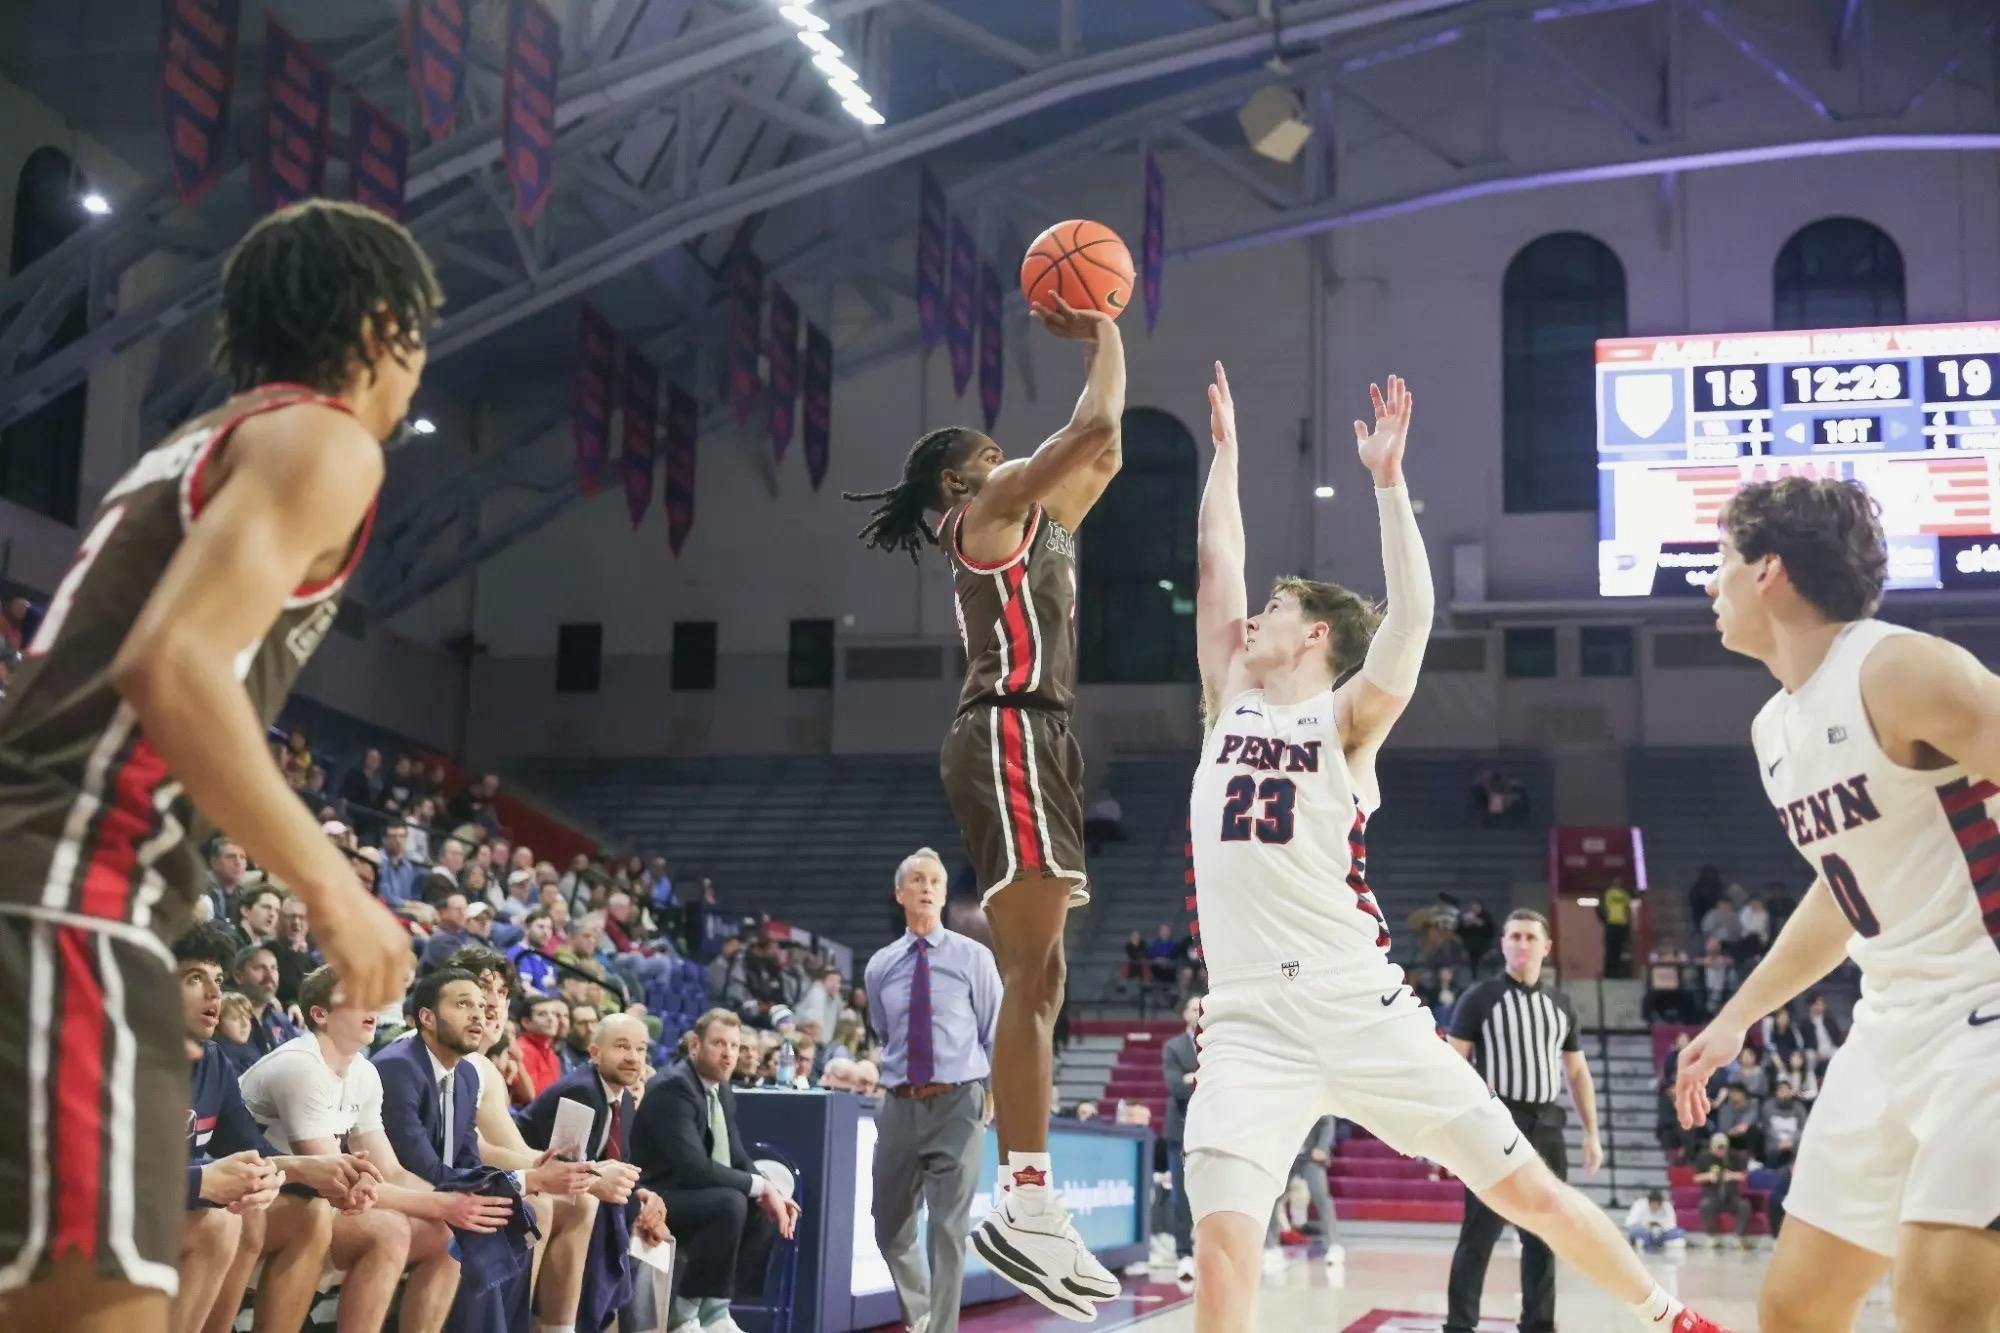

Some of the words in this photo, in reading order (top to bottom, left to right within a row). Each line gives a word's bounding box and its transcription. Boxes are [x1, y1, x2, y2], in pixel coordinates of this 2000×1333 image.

[1705, 369, 1758, 407] 15
[1938, 358, 1993, 397] 19
[1216, 734, 1322, 773] PENN
[1221, 774, 1297, 845] 23
[1821, 852, 1881, 938] 0
